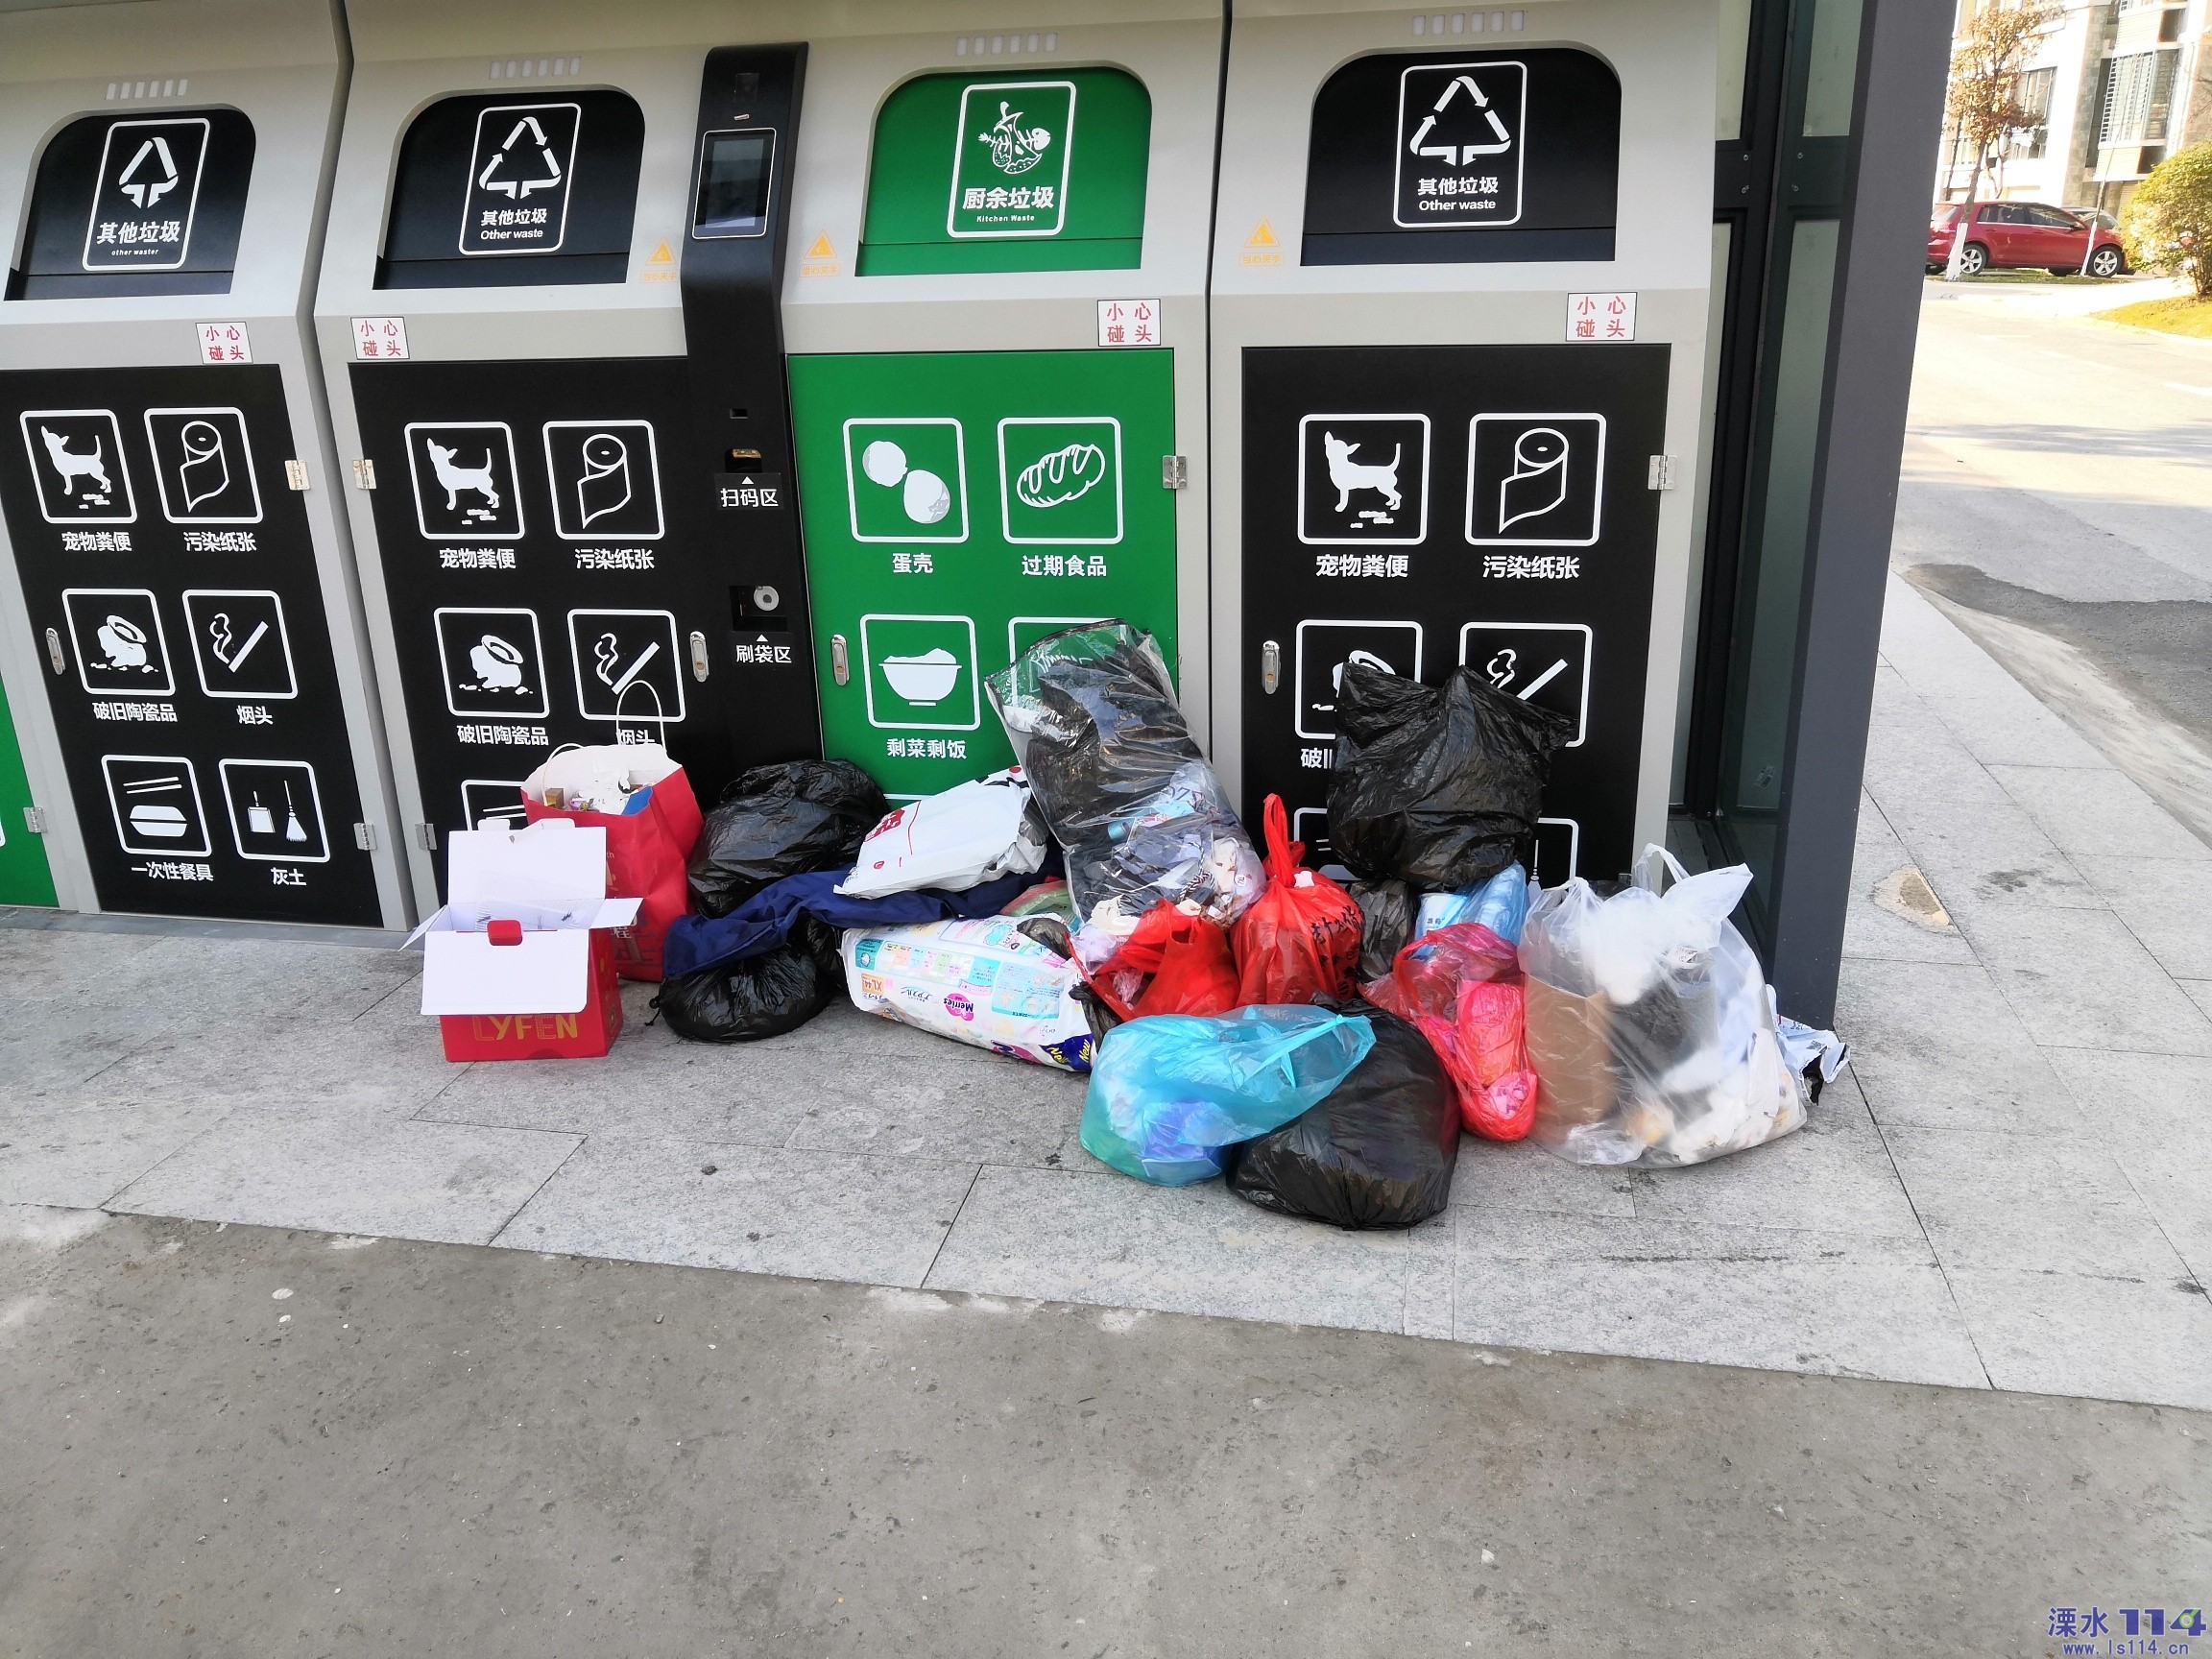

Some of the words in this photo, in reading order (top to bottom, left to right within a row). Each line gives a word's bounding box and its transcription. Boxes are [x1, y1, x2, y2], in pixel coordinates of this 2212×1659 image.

[1418, 177, 1499, 196] 其他垃圾
[962, 185, 1055, 210] 厨余垃圾
[1418, 199, 1457, 211] Other
[1458, 199, 1497, 210] waste
[481, 207, 548, 227] 其他垃圾
[97, 220, 180, 244] 其他垃圾
[480, 228, 511, 240] Other
[511, 228, 544, 239] waste
[1106, 302, 1152, 322] 小心
[1576, 296, 1626, 315] 小心
[205, 325, 241, 341] 小心
[360, 320, 397, 337] 小心
[1107, 325, 1152, 343] 碰头
[1575, 319, 1625, 337] 碰头
[207, 345, 245, 361] 碰头
[362, 340, 401, 356] 碰头
[720, 487, 780, 508] 扫码区
[61, 531, 132, 552] 宠物粪便
[182, 531, 257, 553] 污染纸张
[439, 547, 517, 569] 宠物粪便
[575, 547, 656, 570] 污染纸张
[892, 552, 934, 574] 蛋壳
[1022, 554, 1107, 577] 过期食品
[1315, 553, 1409, 578] 宠物粪便
[1482, 555, 1580, 580] 污染纸张
[735, 644, 792, 663] 刷袋区
[92, 701, 179, 722] 破旧陶瓷品
[236, 705, 274, 725] 烟头
[456, 724, 549, 746] 破旧陶瓷品
[886, 737, 968, 759] 剩菜剩饭
[131, 861, 214, 882] 一次性餐具
[270, 867, 307, 886] 灰土
[944, 998, 974, 1012] Merries
[471, 1013, 578, 1041] LYFEN
[1078, 1038, 1091, 1063] New
